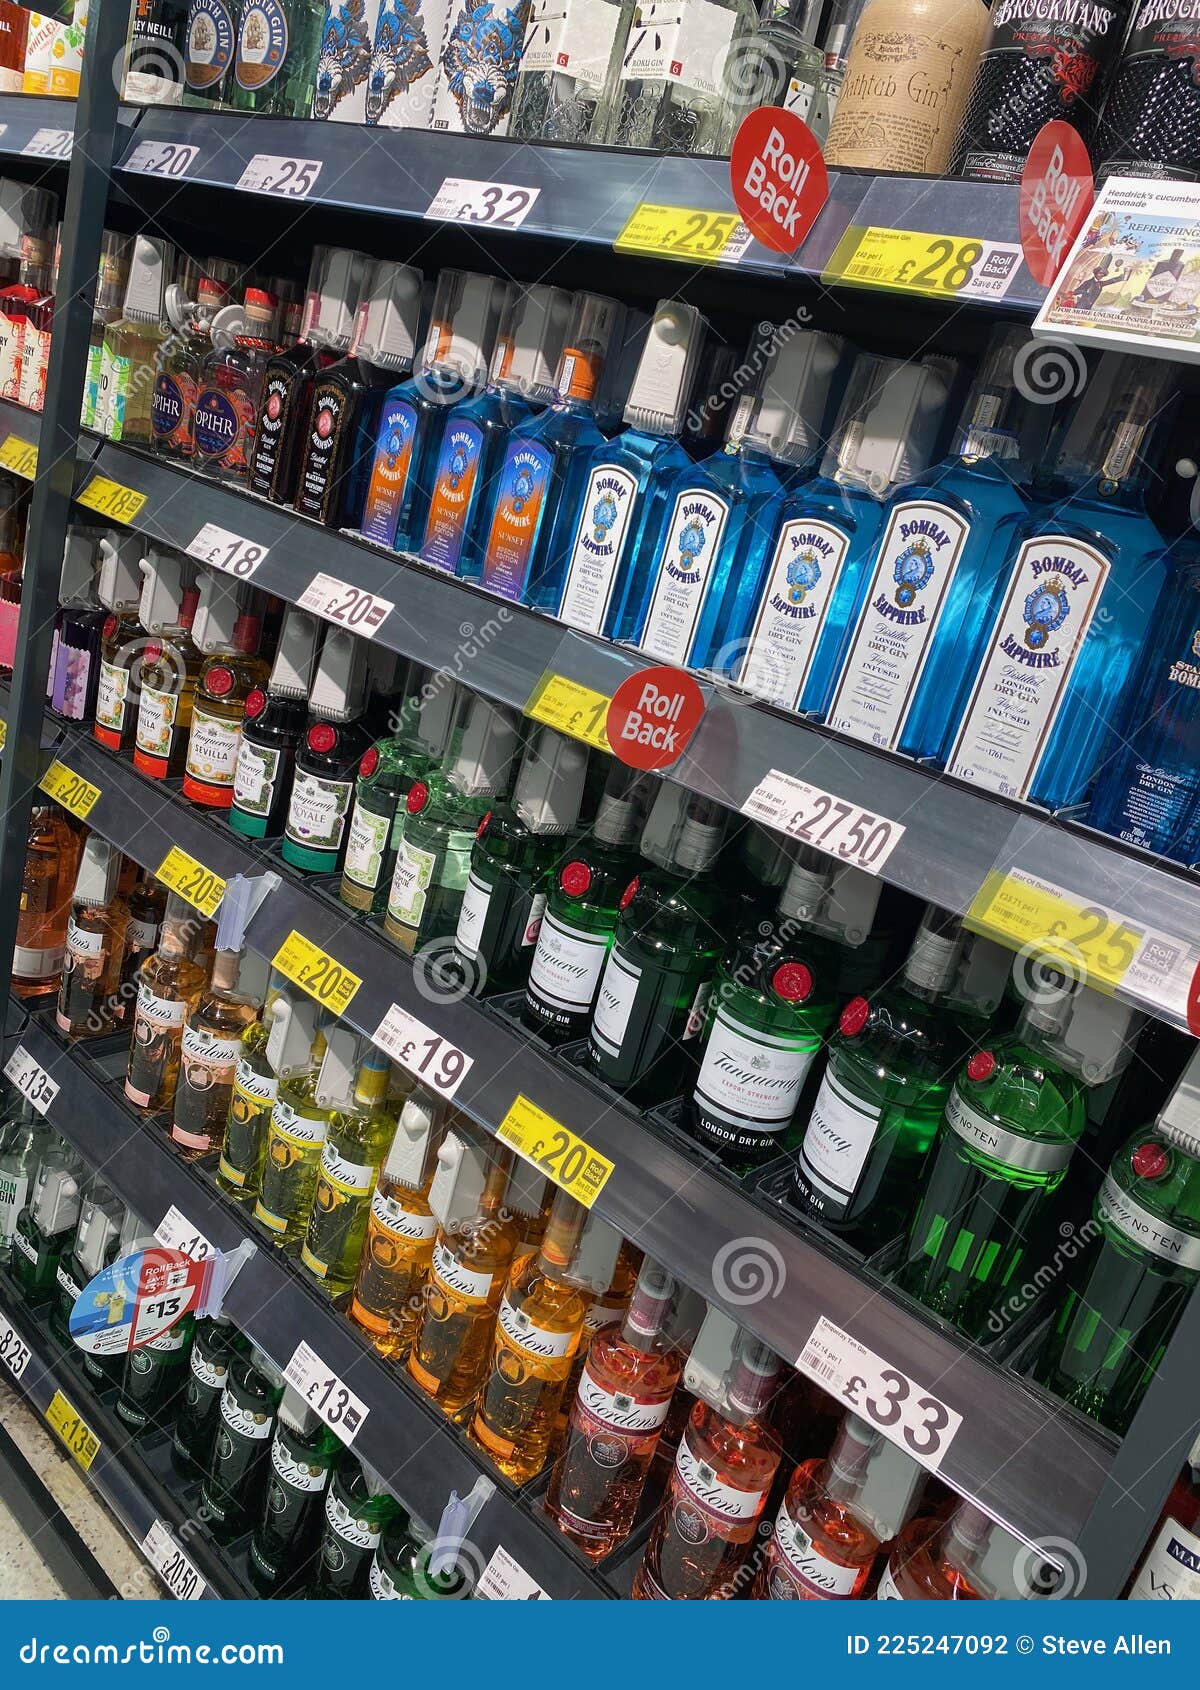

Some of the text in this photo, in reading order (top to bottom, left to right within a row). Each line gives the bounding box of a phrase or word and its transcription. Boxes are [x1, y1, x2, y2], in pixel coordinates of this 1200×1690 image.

[993, 0, 1117, 36] BROCKMANS
[147, 24, 174, 40] NEILL
[907, 71, 940, 109] Gin
[762, 126, 810, 197] Roll
[1132, 160, 1164, 171] INFUSED
[260, 161, 319, 196] £25
[1046, 143, 1081, 223] Roll
[455, 187, 531, 227] £32
[743, 156, 801, 238] Back
[1103, 197, 1147, 209] lemonade
[1107, 189, 1200, 204] Hendrick's cucumber
[1028, 182, 1067, 269] Back
[894, 239, 984, 291] £28
[984, 263, 1010, 276] Back
[990, 254, 1013, 266] Roll
[972, 277, 991, 289] Save
[195, 408, 234, 437] OPIHR
[387, 412, 410, 433] BOMBAY
[450, 432, 476, 453] BOMBAY
[377, 461, 402, 481] SAPPHIRE
[514, 452, 542, 474] BOMBAY
[375, 484, 397, 499] SUNSET
[439, 483, 465, 503] SAPPHIRE
[596, 477, 628, 501] BOMBAY
[436, 506, 460, 520] SUNSET
[501, 506, 531, 528] SAPPHIRE
[683, 502, 717, 527] BOMBAY
[498, 530, 525, 546] SUNSET
[580, 532, 615, 557] SAPPHIRE
[790, 532, 836, 560] BOMBAY
[899, 519, 952, 551] BOMBAY
[205, 540, 262, 576] £18
[665, 559, 702, 584] SAPPHIRE
[1030, 555, 1090, 590] BOMBAY
[324, 588, 373, 625] £20
[769, 592, 818, 619] SAPPHIRE
[871, 592, 929, 627] SAPPHIRE
[767, 629, 803, 647] DRY GIN
[772, 625, 800, 638] LONDON
[874, 621, 916, 645] Distilled
[874, 635, 907, 650] LONDON
[763, 648, 797, 662] INFUSED
[867, 640, 910, 661] DRY GIN
[999, 633, 1062, 670] SAPPHIRE
[861, 661, 901, 681] INFUSED
[1000, 664, 1046, 689] Distilled
[992, 683, 1041, 706] DRY GIN
[1000, 677, 1038, 695] LONDON
[636, 682, 686, 722] Roll
[569, 699, 610, 740] £1
[986, 705, 1031, 727] INFUSED
[193, 728, 236, 751] Tanqueray
[620, 710, 681, 753] Back
[194, 744, 228, 761] SEVILLA
[1138, 779, 1175, 796] DRY GIN
[1141, 773, 1176, 790] LONDON
[293, 787, 336, 812] Tanqueray
[293, 803, 327, 824] ROYALE
[785, 795, 892, 867] £27.50
[176, 867, 214, 905] £20
[1011, 871, 1027, 882] Star
[1035, 881, 1064, 899] Bombay
[535, 935, 590, 980] Tanqueray
[1142, 951, 1172, 970] Back
[1150, 943, 1174, 960] Roll
[297, 956, 342, 1000] £20
[1128, 964, 1149, 982] Save
[540, 1006, 571, 1025] DRY GIN
[183, 1030, 236, 1060] Gordon's
[400, 1036, 466, 1090] £19
[711, 1050, 800, 1096] Tanqueray
[19, 1066, 48, 1102] £13
[721, 1078, 781, 1103] EXPORT STRENGTH
[271, 1101, 316, 1141] Gordon's
[700, 1117, 775, 1148] LONDON DRY GIN
[959, 1115, 1000, 1149] No TEN
[528, 1130, 588, 1185] £20
[589, 1161, 604, 1175] Roll
[584, 1169, 601, 1185] Back
[797, 1180, 825, 1212] DRY GIN
[371, 1195, 425, 1238] Gordon's
[1131, 1217, 1183, 1255] No TEN
[145, 1297, 181, 1318] £13
[498, 1304, 555, 1356] Gordon's
[820, 1318, 867, 1356] Tanqueray Ten Gin
[828, 1350, 839, 1362] per
[306, 1377, 350, 1424] £13
[584, 1382, 659, 1430] Gordon's
[841, 1369, 950, 1456] £33
[680, 1452, 743, 1518] Gordon's
[776, 1514, 837, 1591] Gordon's
